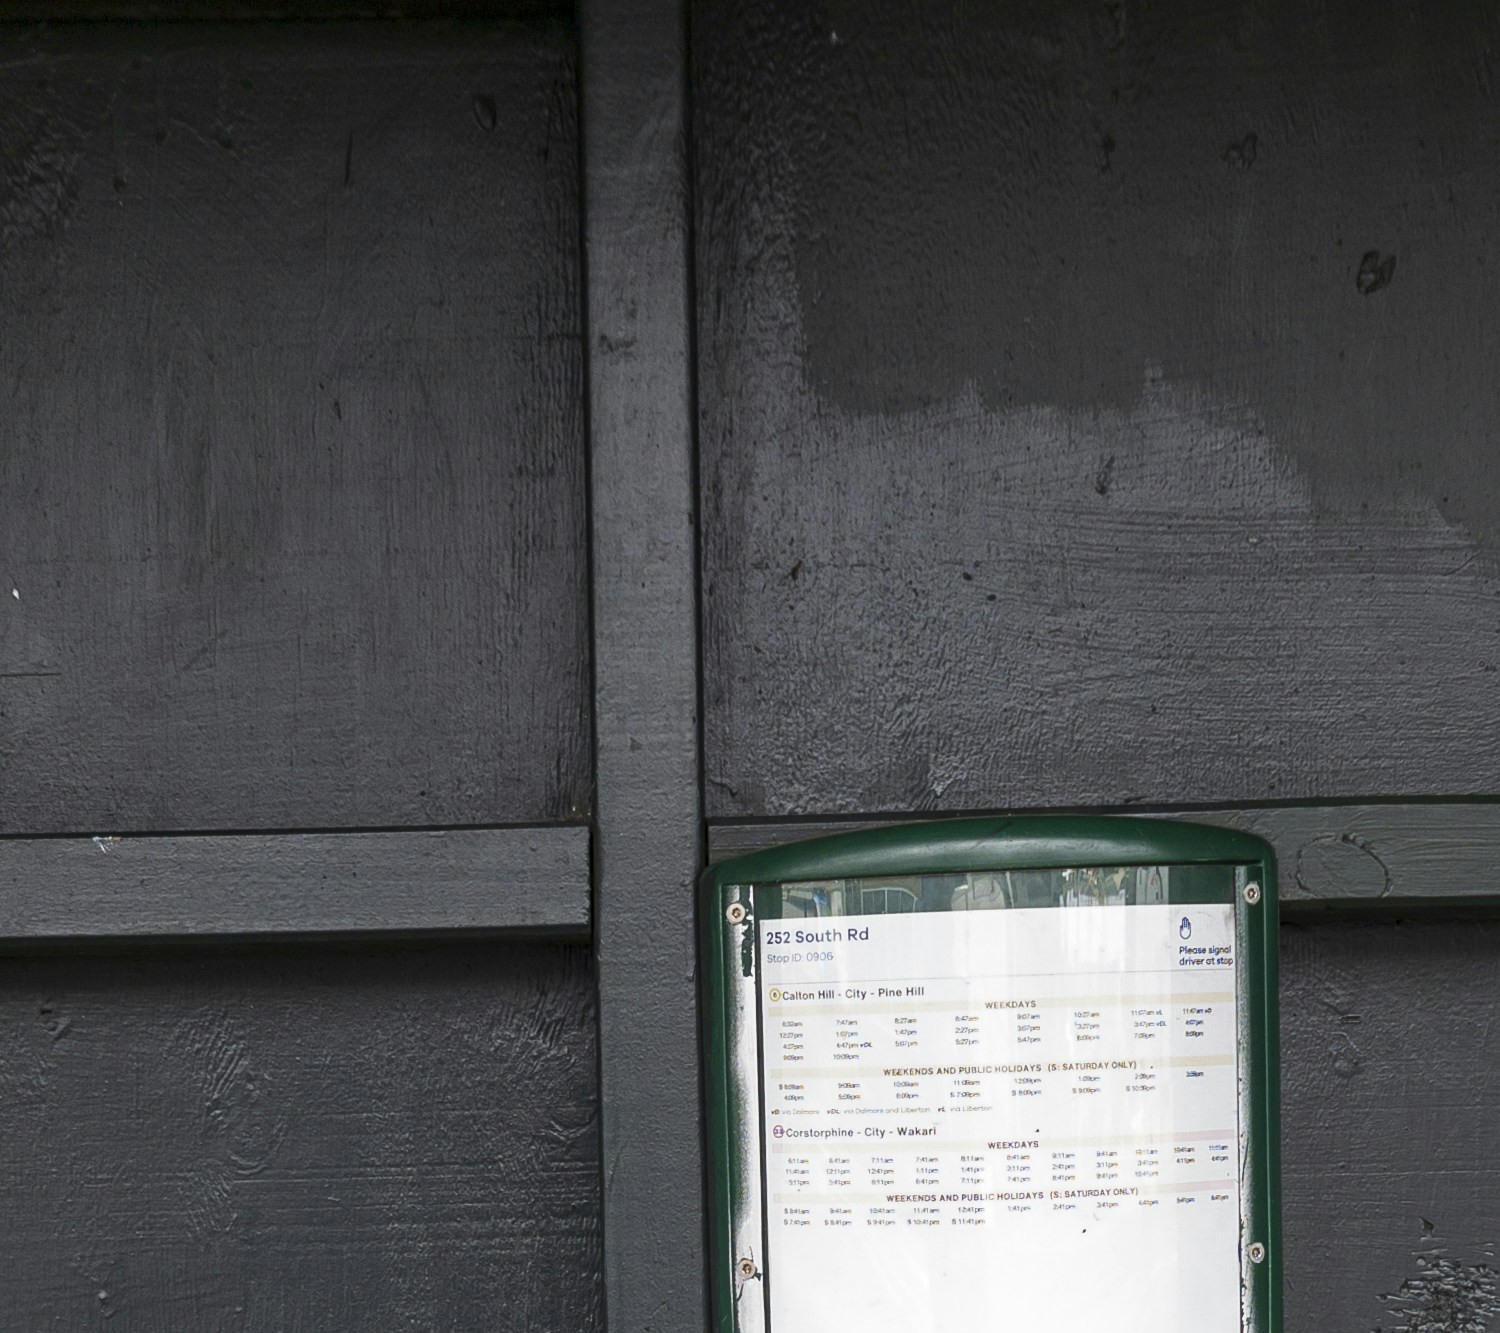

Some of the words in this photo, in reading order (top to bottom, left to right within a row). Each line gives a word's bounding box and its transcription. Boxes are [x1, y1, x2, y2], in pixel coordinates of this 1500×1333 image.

[767, 932, 790, 944] 252
[796, 931, 841, 943] South
[848, 927, 868, 940] Rd
[1179, 946, 1206, 954] Please
[1209, 945, 1231, 955] signal
[767, 954, 789, 963] Stop
[806, 952, 834, 961] 0906
[1206, 957, 1215, 965] at
[1217, 957, 1233, 966] stop
[781, 992, 814, 1000] Calton
[818, 990, 834, 999] Hill
[846, 989, 866, 1000] City
[878, 988, 902, 996] Pine
[906, 987, 924, 996] Hill
[883, 1068, 933, 1076] WEEKENDS
[959, 1066, 992, 1074] PUBLIC
[1063, 1062, 1109, 1070] SATURDAY
[1112, 1061, 1136, 1069] ONLY)
[785, 1128, 853, 1137] Corstorphine
[865, 1128, 885, 1138] City
[897, 1127, 936, 1135] Wakari
[988, 1141, 1038, 1149] WEEKDAYS
[997, 1192, 1044, 1200] HOLIDAYS
[1065, 1189, 1111, 1197] SATURDAY
